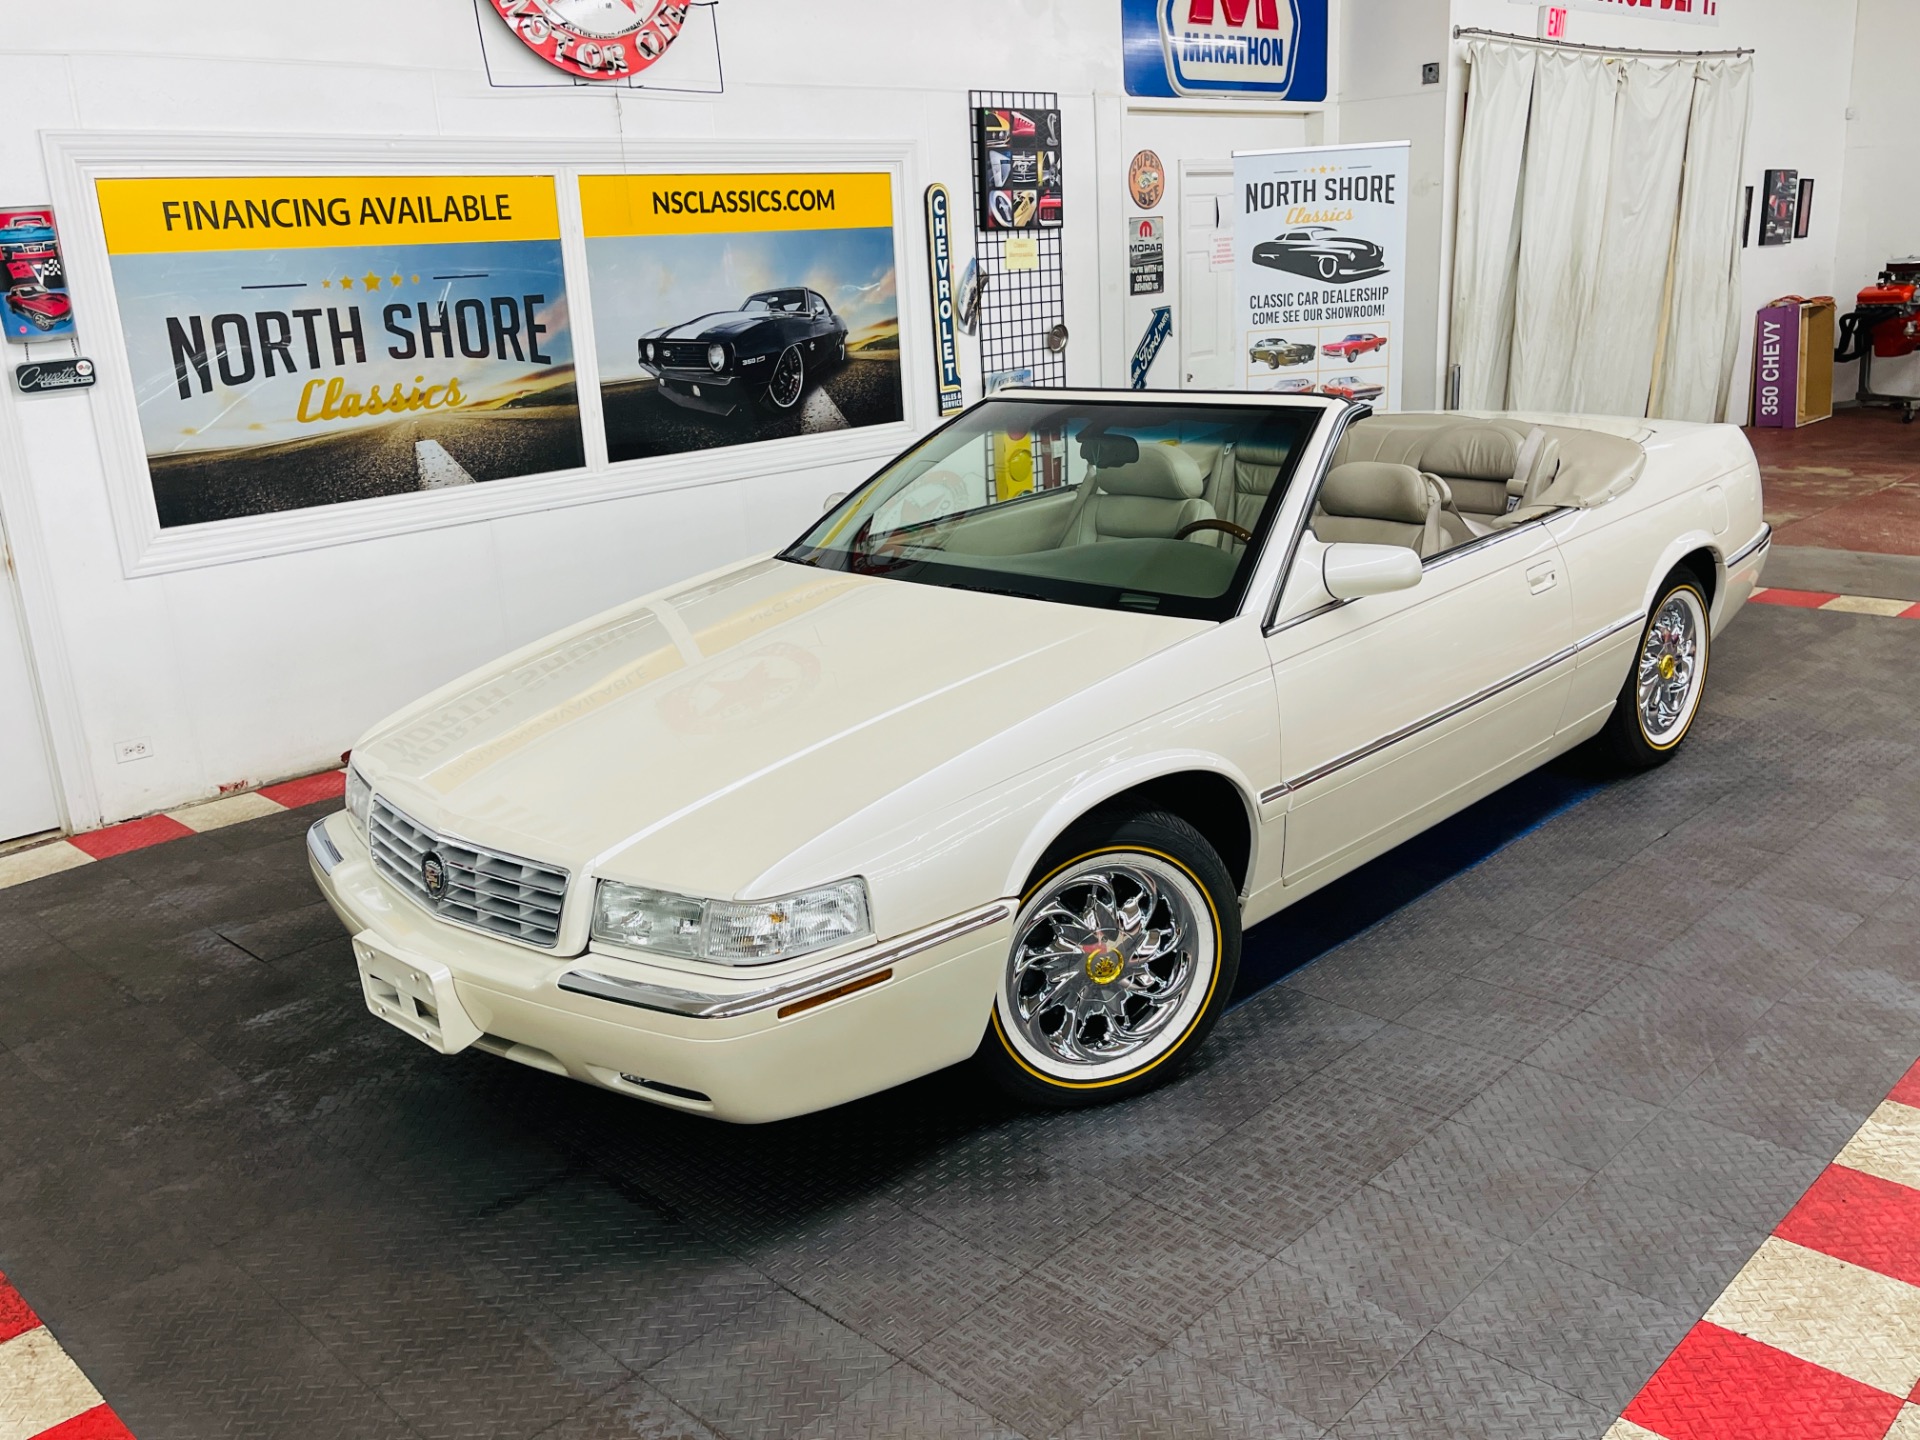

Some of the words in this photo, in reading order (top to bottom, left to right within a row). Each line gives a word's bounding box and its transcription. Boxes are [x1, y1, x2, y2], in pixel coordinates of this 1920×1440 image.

[1548, 7, 1567, 37] EXIT
[1183, 32, 1284, 66] MARATHON
[652, 189, 835, 214] NSCLASSICS.COM
[1138, 185, 1160, 206] BEE
[1245, 179, 1316, 214] NORTH
[1325, 174, 1396, 204] SHORE
[162, 197, 350, 231] FINANCING
[359, 193, 512, 225] AVAILABLE
[1286, 207, 1354, 225] Classics
[1129, 243, 1162, 253] MOPAR
[933, 195, 955, 382] CHEVROLET
[1250, 292, 1294, 309] CLASSIC
[1297, 291, 1319, 306] CAR
[1322, 286, 1389, 304] DEALERSHIP
[1252, 310, 1280, 325] COME
[1283, 308, 1300, 323] SEE
[1303, 307, 1323, 321] OUR
[1325, 304, 1385, 319] SHOWROOM!
[166, 306, 367, 400] NORTH
[383, 294, 552, 364] SHORE
[1139, 327, 1161, 370] Ford
[1157, 311, 1170, 331] PARTS
[1761, 321, 1781, 382] CHEVY
[19, 366, 79, 389] Corvette
[297, 375, 467, 423] Classics
[942, 393, 957, 402] SALES
[942, 399, 962, 409] SERVICE
[1761, 386, 1779, 416] 350
